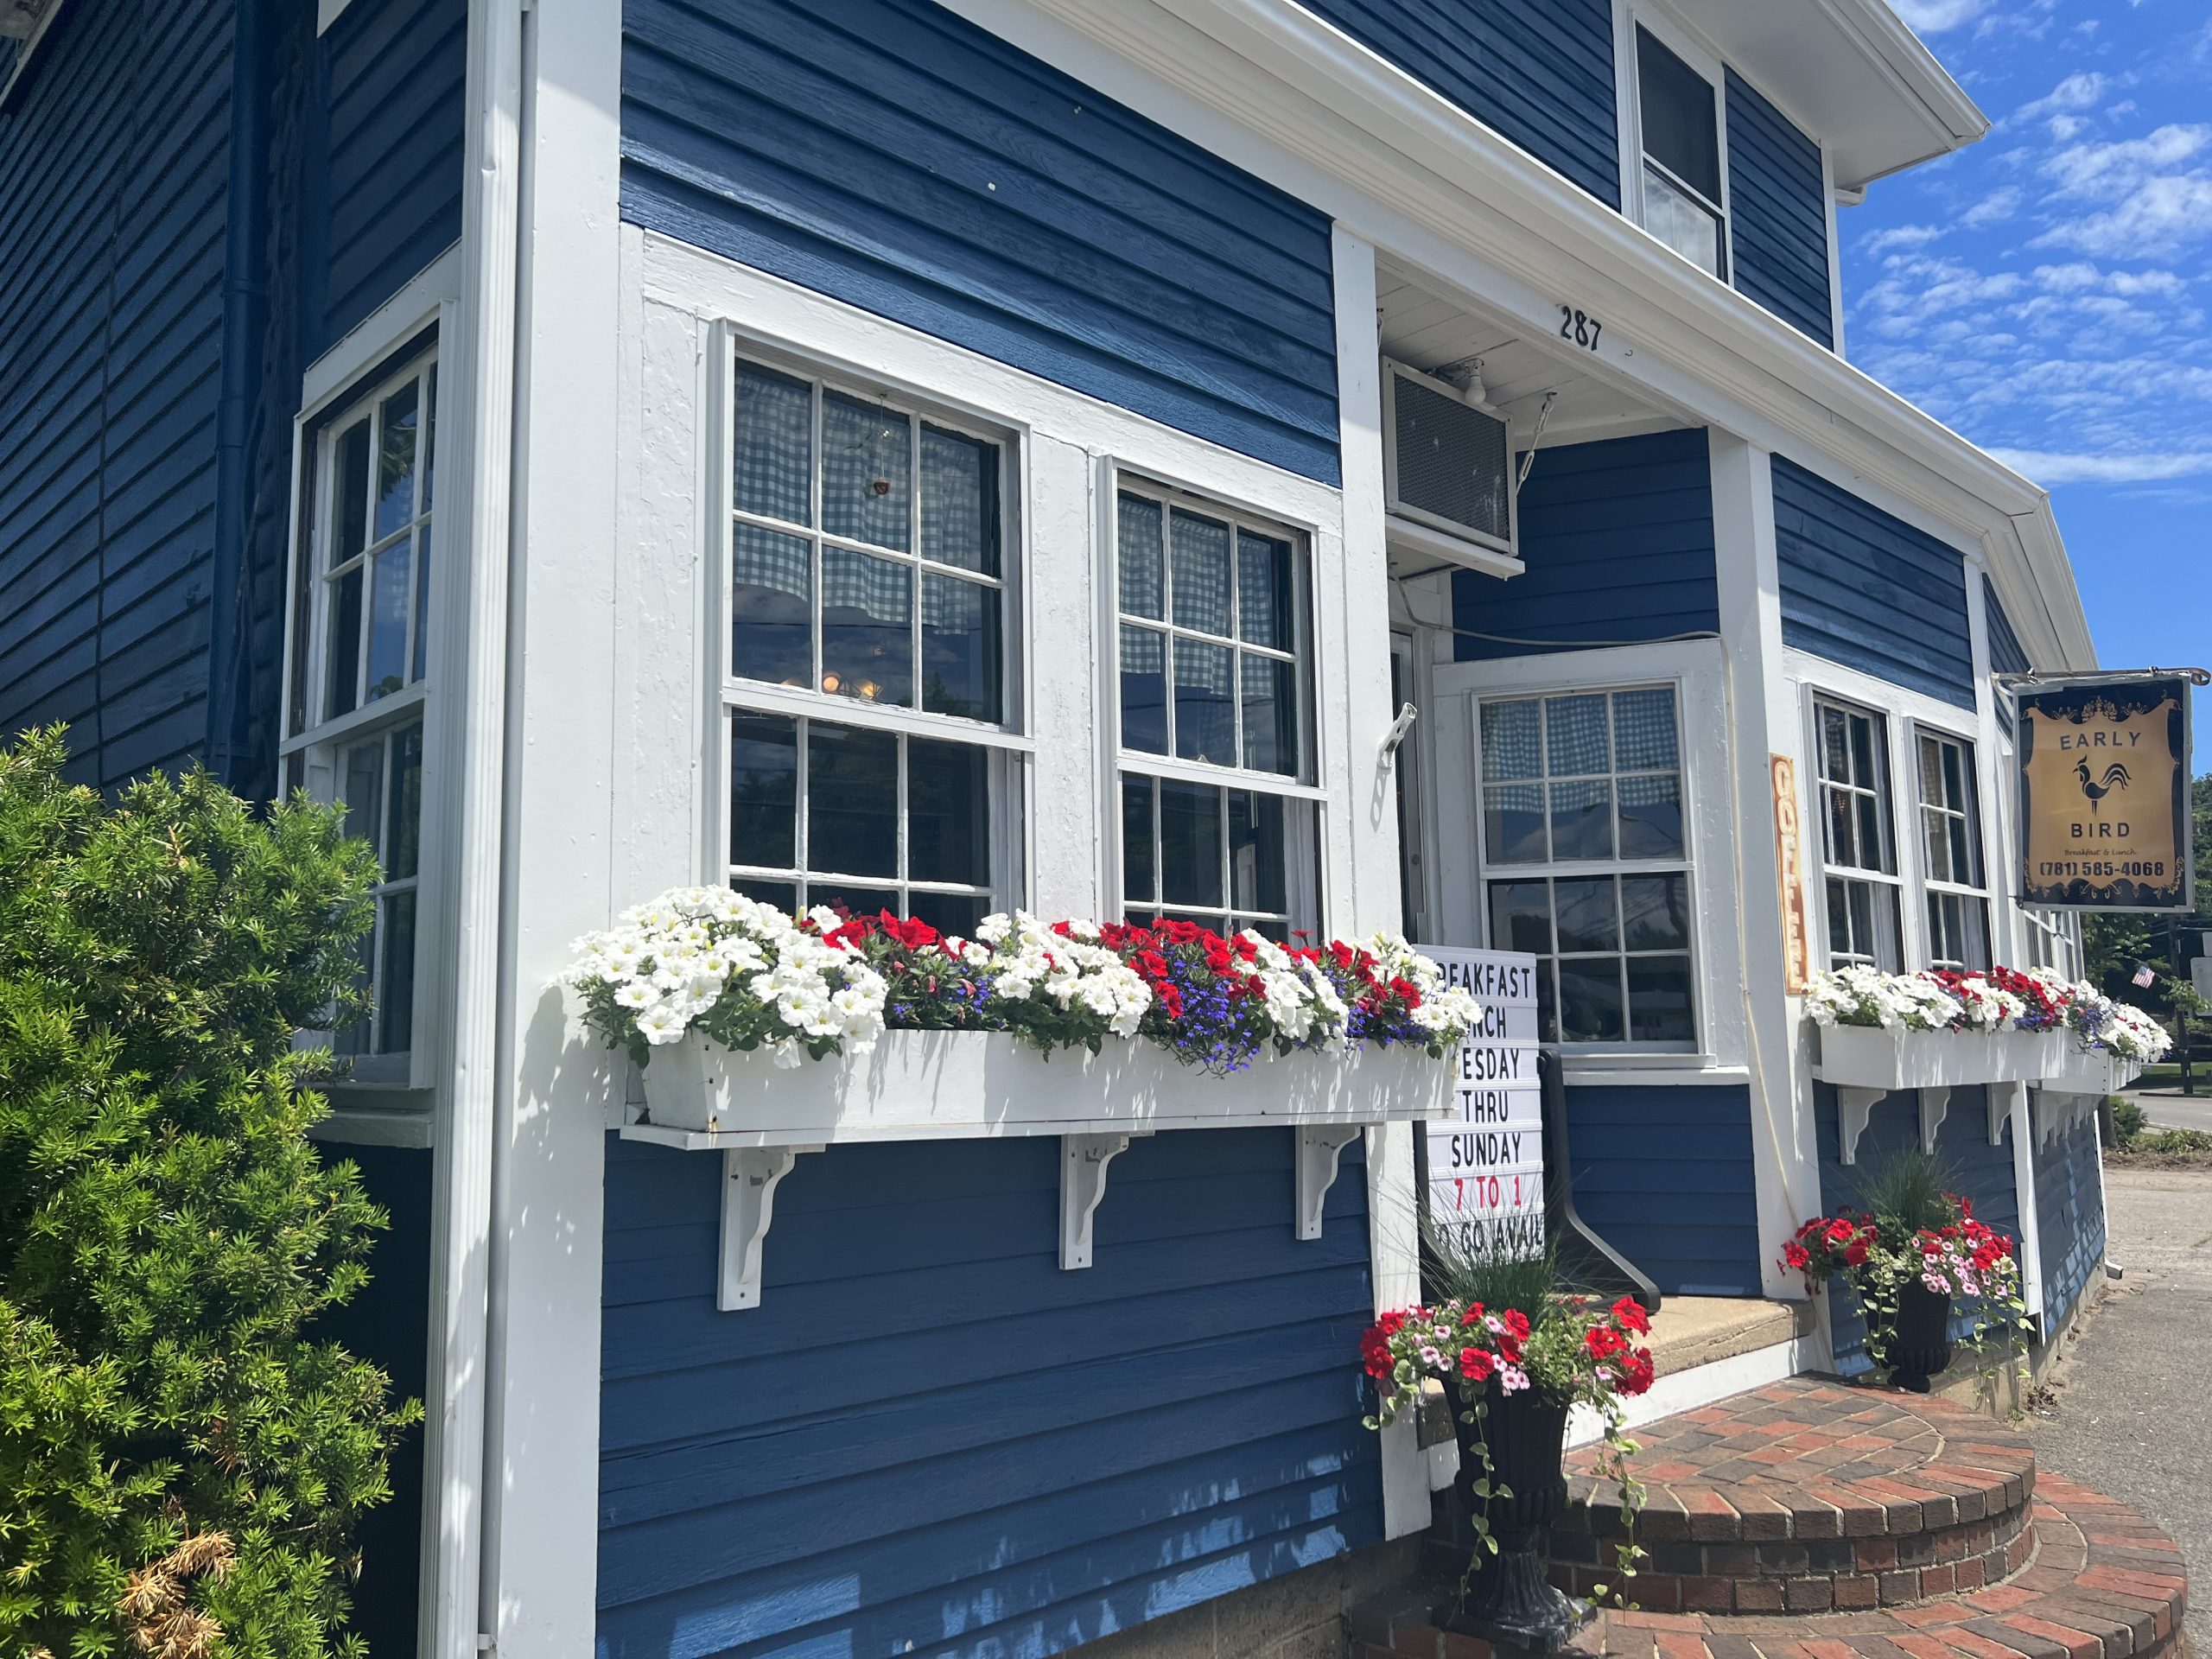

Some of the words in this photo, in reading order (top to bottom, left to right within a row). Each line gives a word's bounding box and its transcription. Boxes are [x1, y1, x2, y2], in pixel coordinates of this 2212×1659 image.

[1560, 305, 1602, 352] 287
[2059, 731, 2141, 751] EARLY
[2071, 823, 2130, 838] BIRD
[2039, 861, 2078, 876] (781)
[2082, 861, 2164, 876] 585-4068
[2064, 849, 2101, 857] Breakfast
[2112, 848, 2137, 856] Lunch
[1774, 760, 1803, 988] COFFEE
[1436, 963, 1530, 998] EAKFAST
[1467, 1005, 1506, 1039] NCH
[1464, 1048, 1520, 1080] ESDAY
[1463, 1090, 1509, 1123] THRU
[1452, 1132, 1522, 1167] SUNDAY
[1454, 1178, 1464, 1211] 7
[1476, 1175, 1500, 1209] TO
[1513, 1174, 1522, 1207] 1
